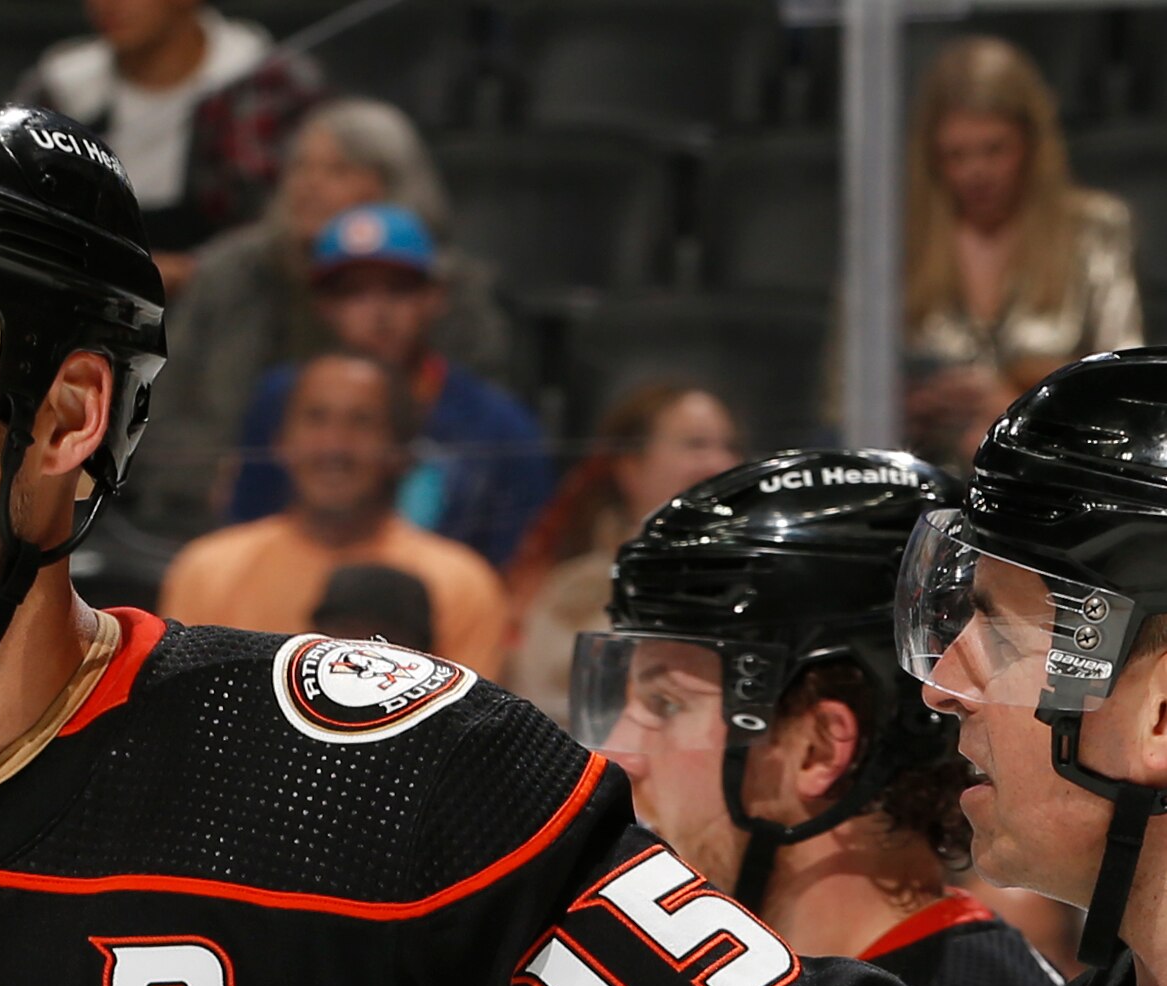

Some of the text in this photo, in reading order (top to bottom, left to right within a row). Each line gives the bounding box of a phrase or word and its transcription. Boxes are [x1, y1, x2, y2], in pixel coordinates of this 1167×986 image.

[29, 129, 82, 156] UCI
[759, 466, 919, 493] UCI Health
[379, 664, 454, 714] DUCKS
